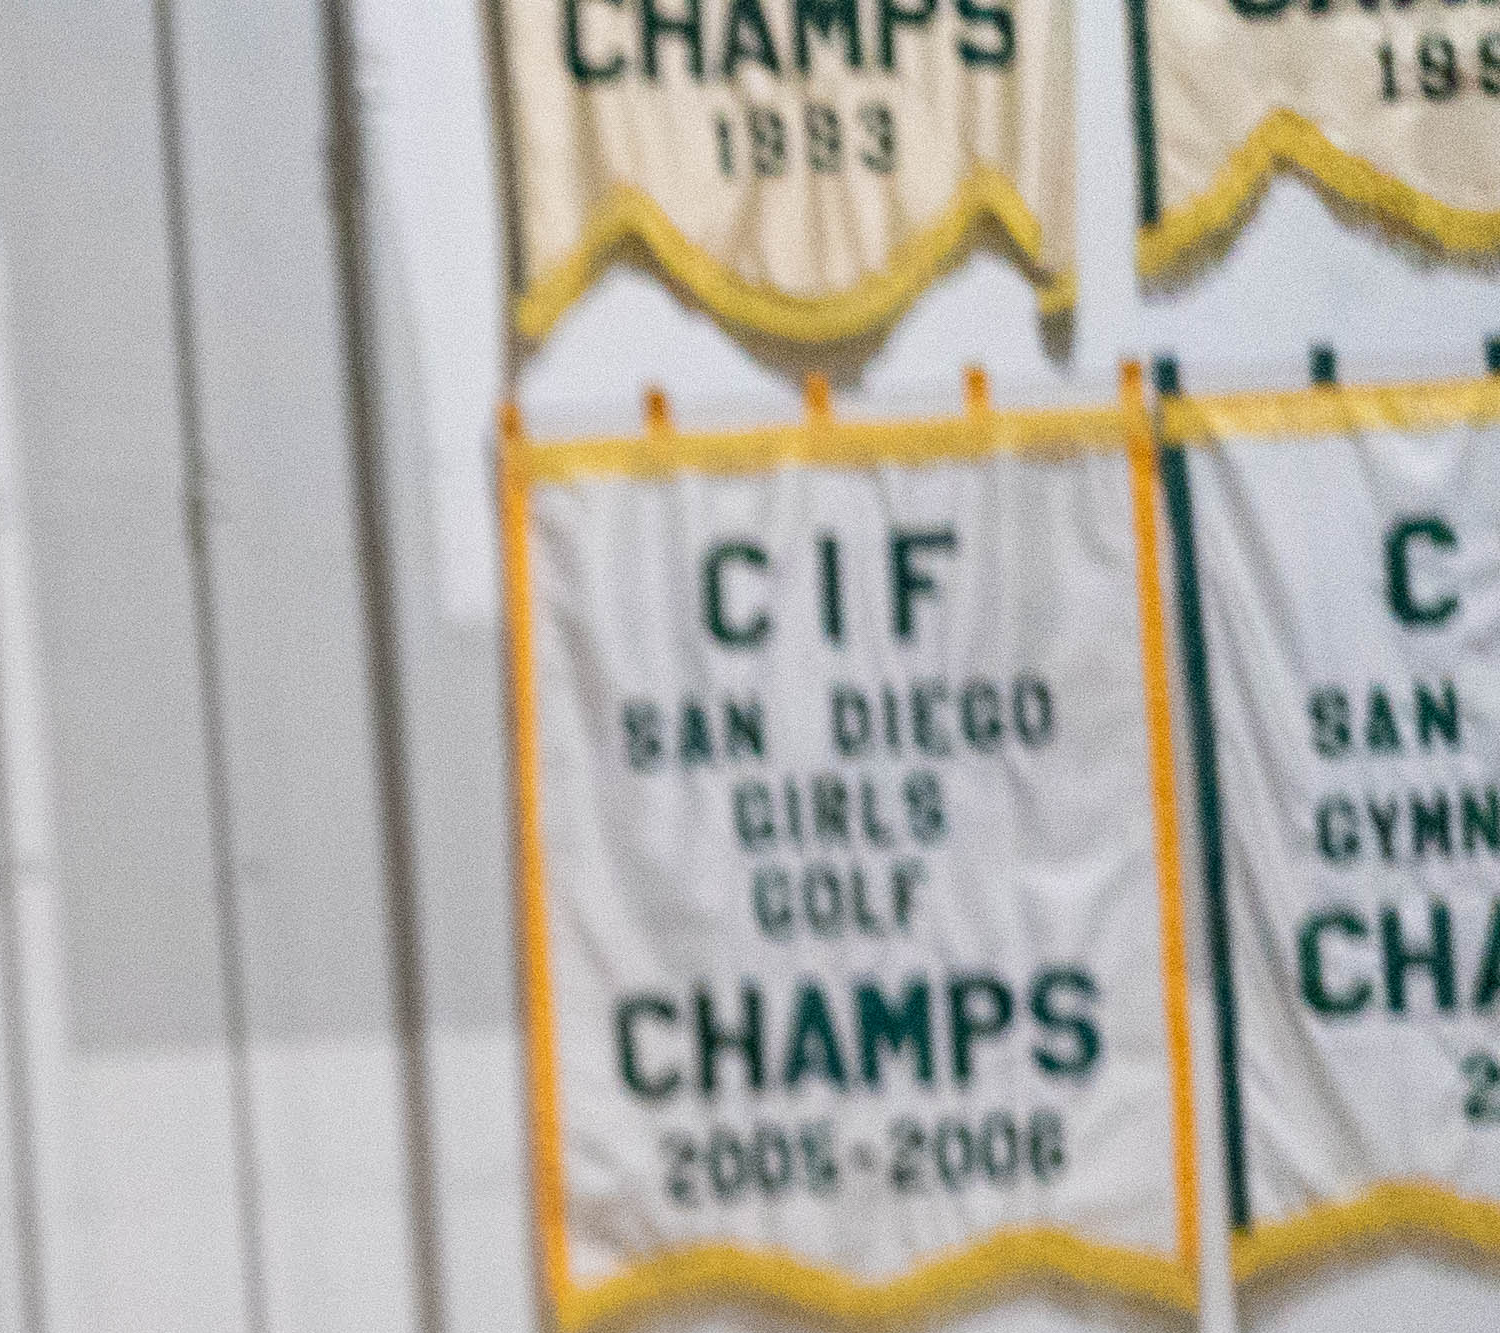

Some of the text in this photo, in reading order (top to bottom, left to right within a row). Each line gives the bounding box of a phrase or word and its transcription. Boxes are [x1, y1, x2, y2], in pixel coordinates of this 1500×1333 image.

[702, 522, 960, 648] CIF
[622, 676, 1056, 772] SAN DIEGO
[1305, 680, 1462, 760] SAN
[730, 768, 950, 852] GIRLS
[752, 860, 925, 938] GOLF
[612, 966, 1104, 1102] CHAMPS
